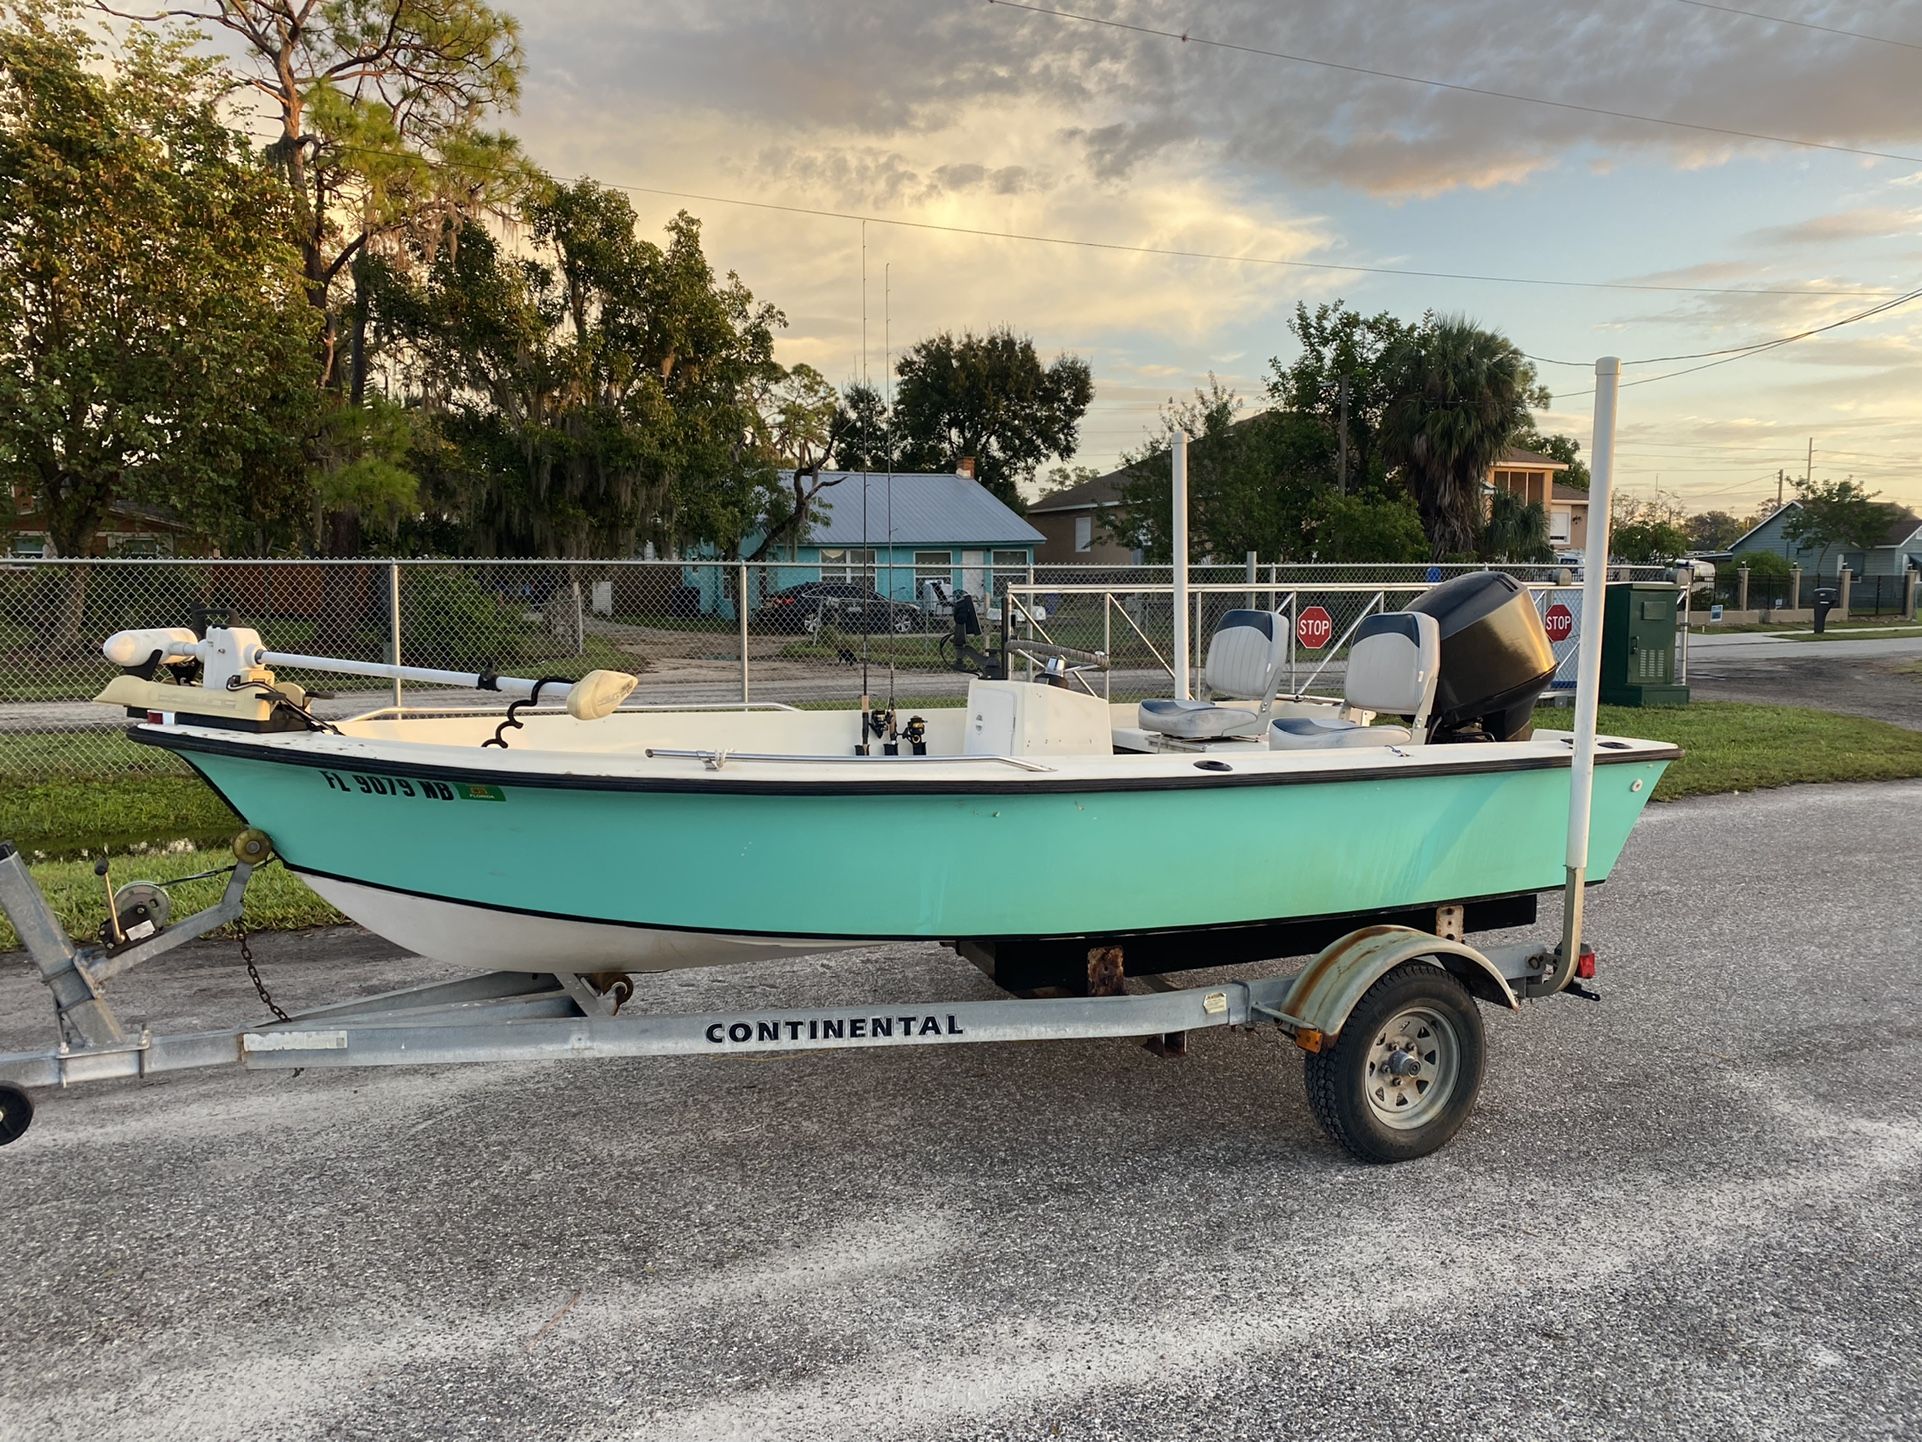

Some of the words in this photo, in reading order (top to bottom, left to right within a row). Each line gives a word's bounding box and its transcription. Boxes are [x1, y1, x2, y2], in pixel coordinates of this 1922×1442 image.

[1300, 620, 1329, 635] STOP
[1546, 616, 1571, 630] STOP
[319, 770, 351, 792] FL
[352, 775, 415, 797] 9079
[705, 1015, 964, 1043] CONTINENTAL
